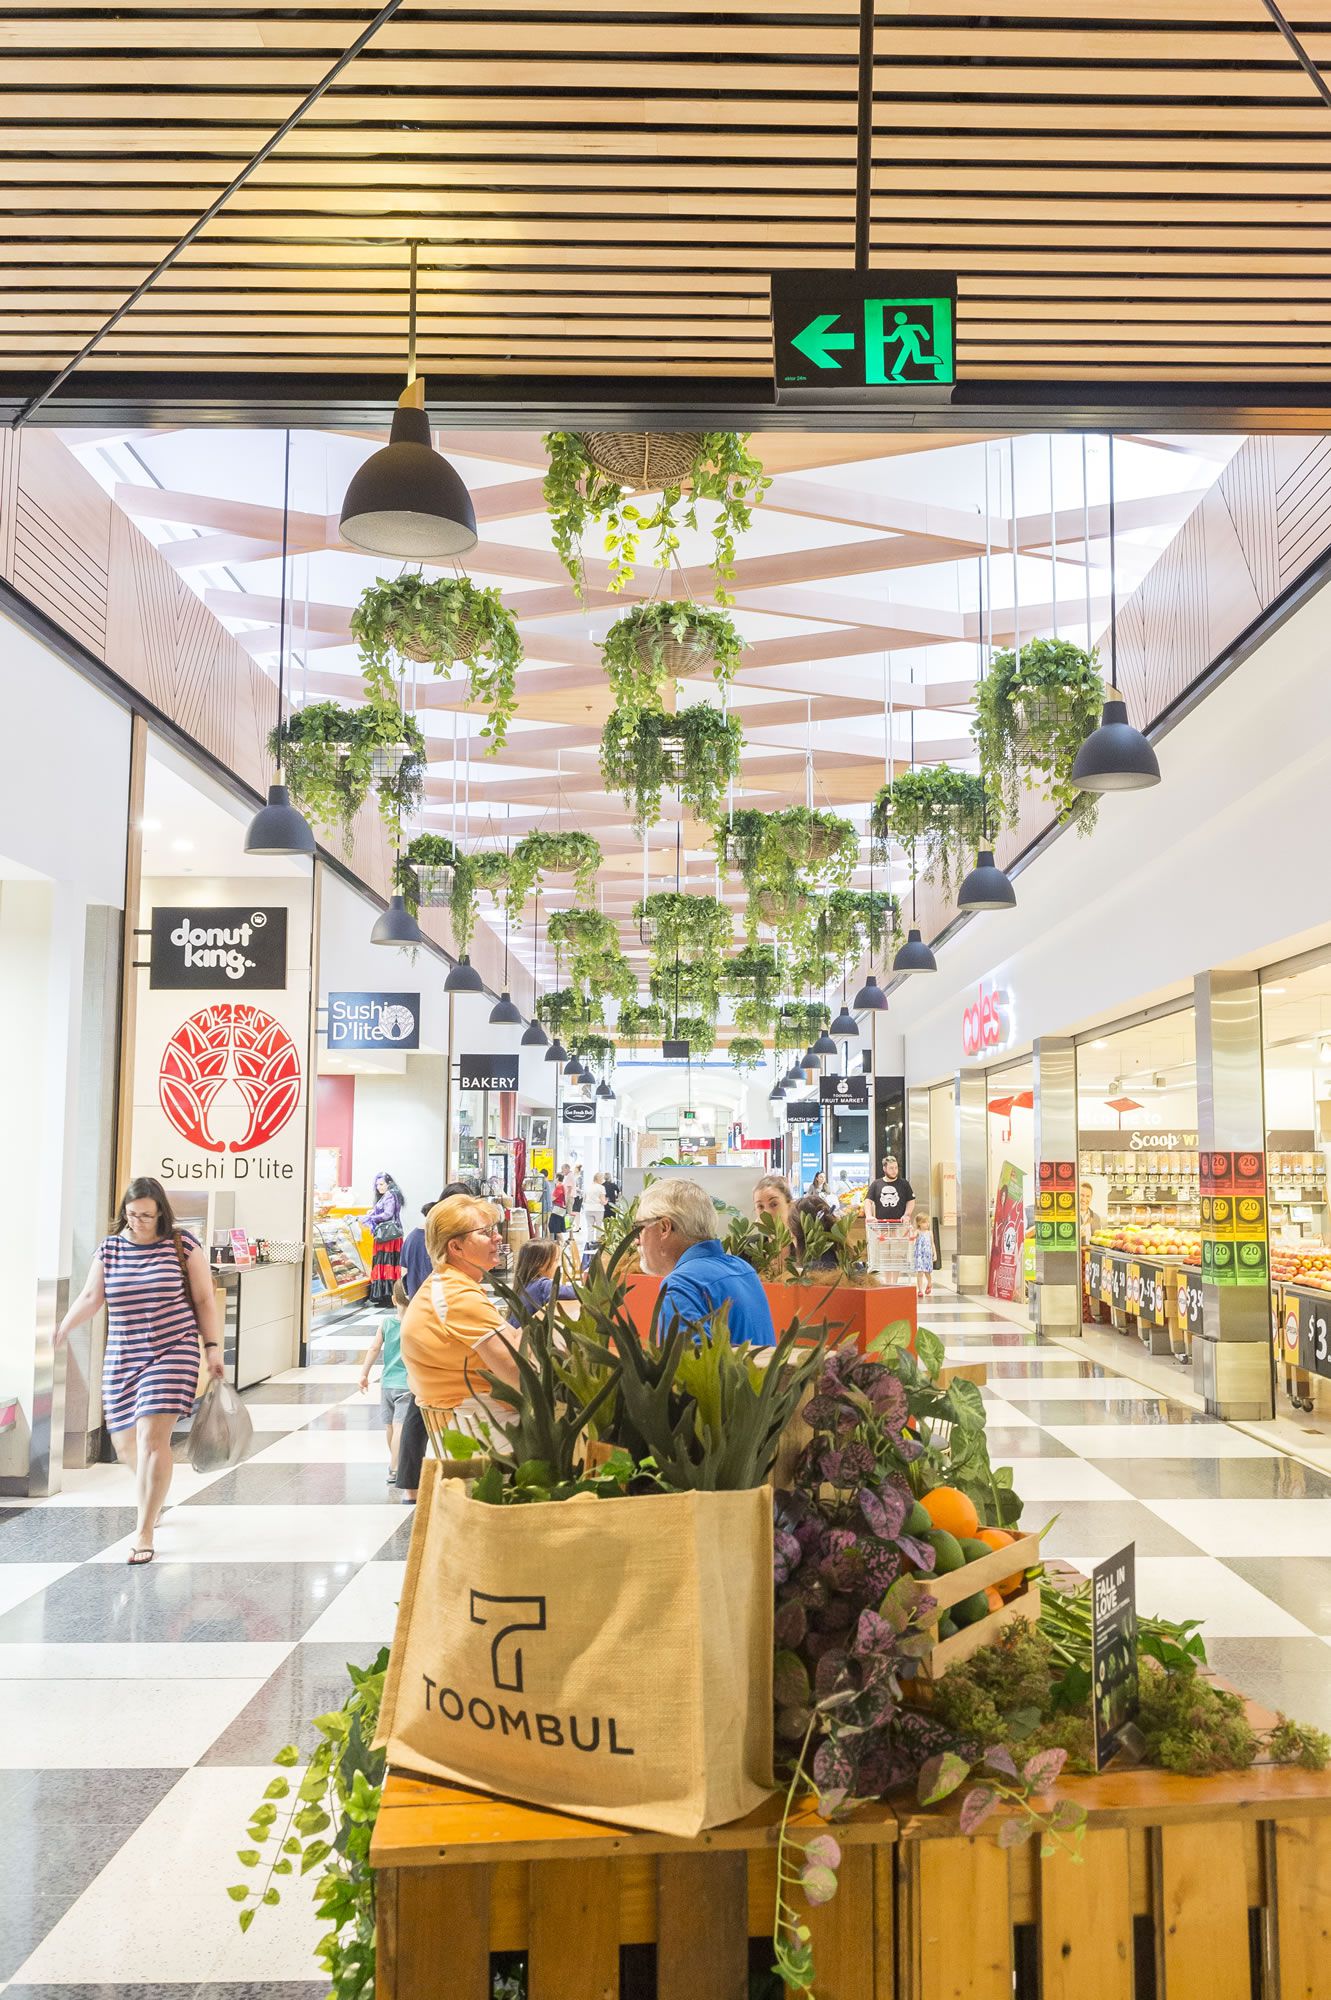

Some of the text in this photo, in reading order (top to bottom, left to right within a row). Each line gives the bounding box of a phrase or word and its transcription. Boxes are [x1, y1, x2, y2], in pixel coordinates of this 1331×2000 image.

[170, 918, 253, 947] donut
[332, 1001, 388, 1020] Sushi
[962, 983, 1002, 1056] coles
[332, 1021, 384, 1041] D'lite
[461, 1077, 516, 1089] BAKERY
[1129, 1131, 1178, 1150] Scoop
[160, 1157, 294, 1180] Sushi D'lite
[1095, 1566, 1126, 1600] FALL IN
[1096, 1589, 1118, 1619] LOVE
[422, 1673, 635, 1756] TOOMBUL
